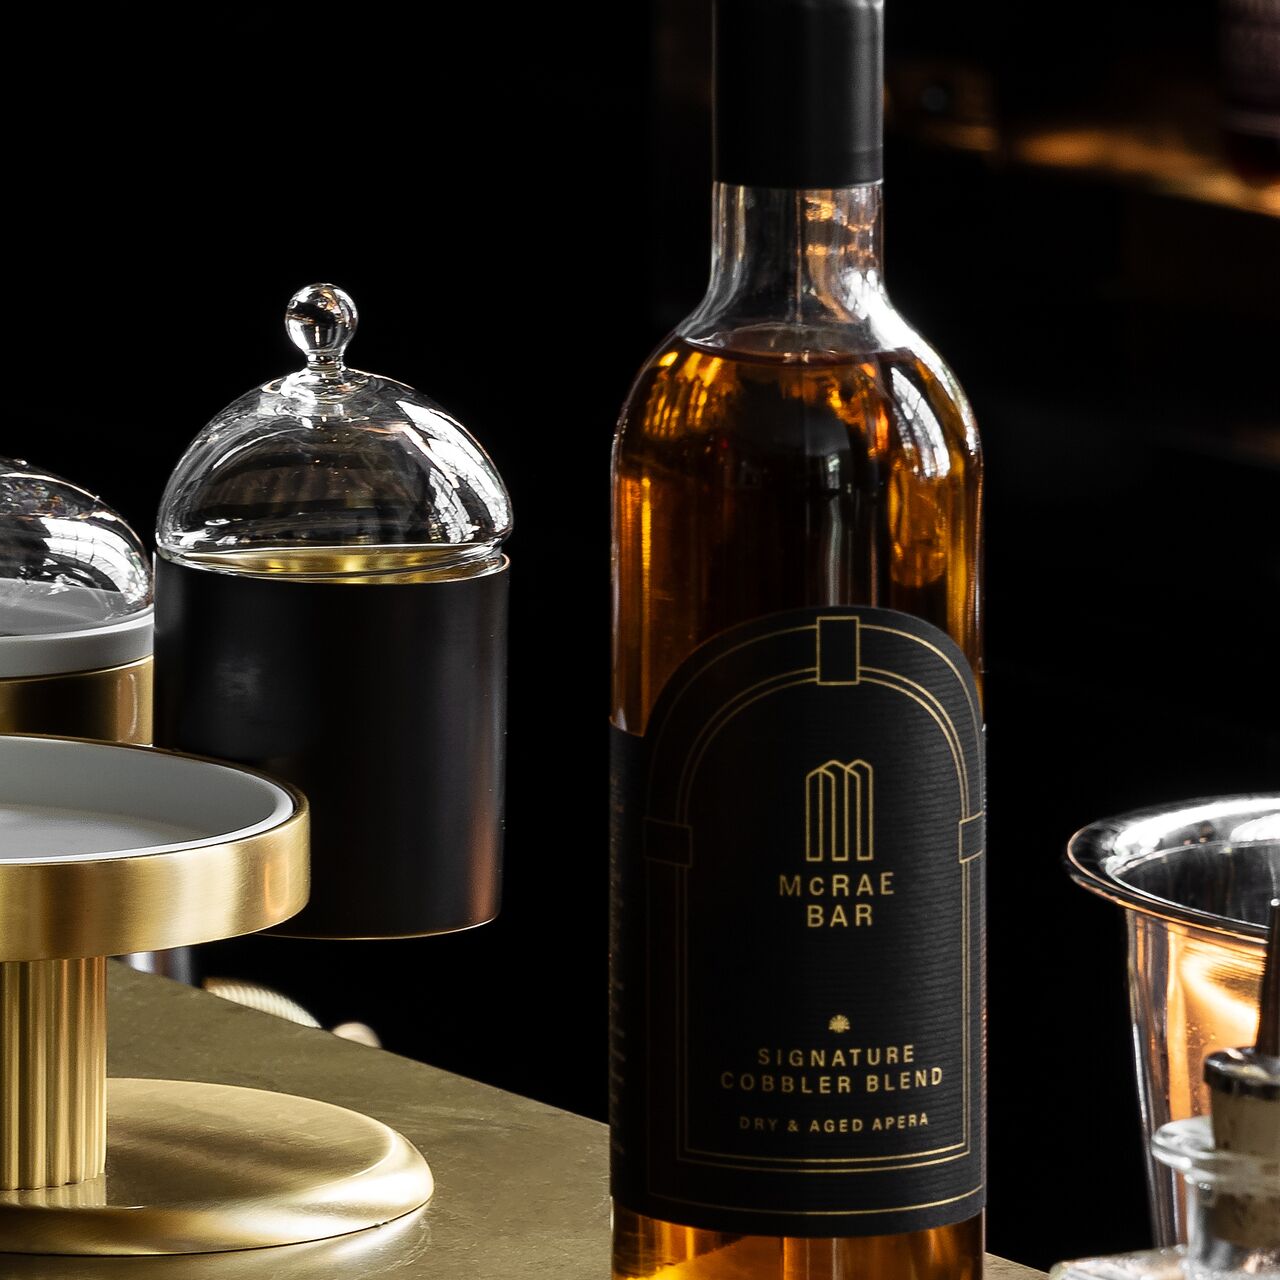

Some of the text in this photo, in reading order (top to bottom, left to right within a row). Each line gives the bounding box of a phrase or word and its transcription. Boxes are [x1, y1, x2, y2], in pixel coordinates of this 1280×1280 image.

[807, 903, 873, 928] BAR
[757, 1044, 915, 1067] SIGNATURE
[720, 1067, 943, 1094] COBBLER BLEND
[739, 1112, 929, 1133] DRY & AGED APERA
